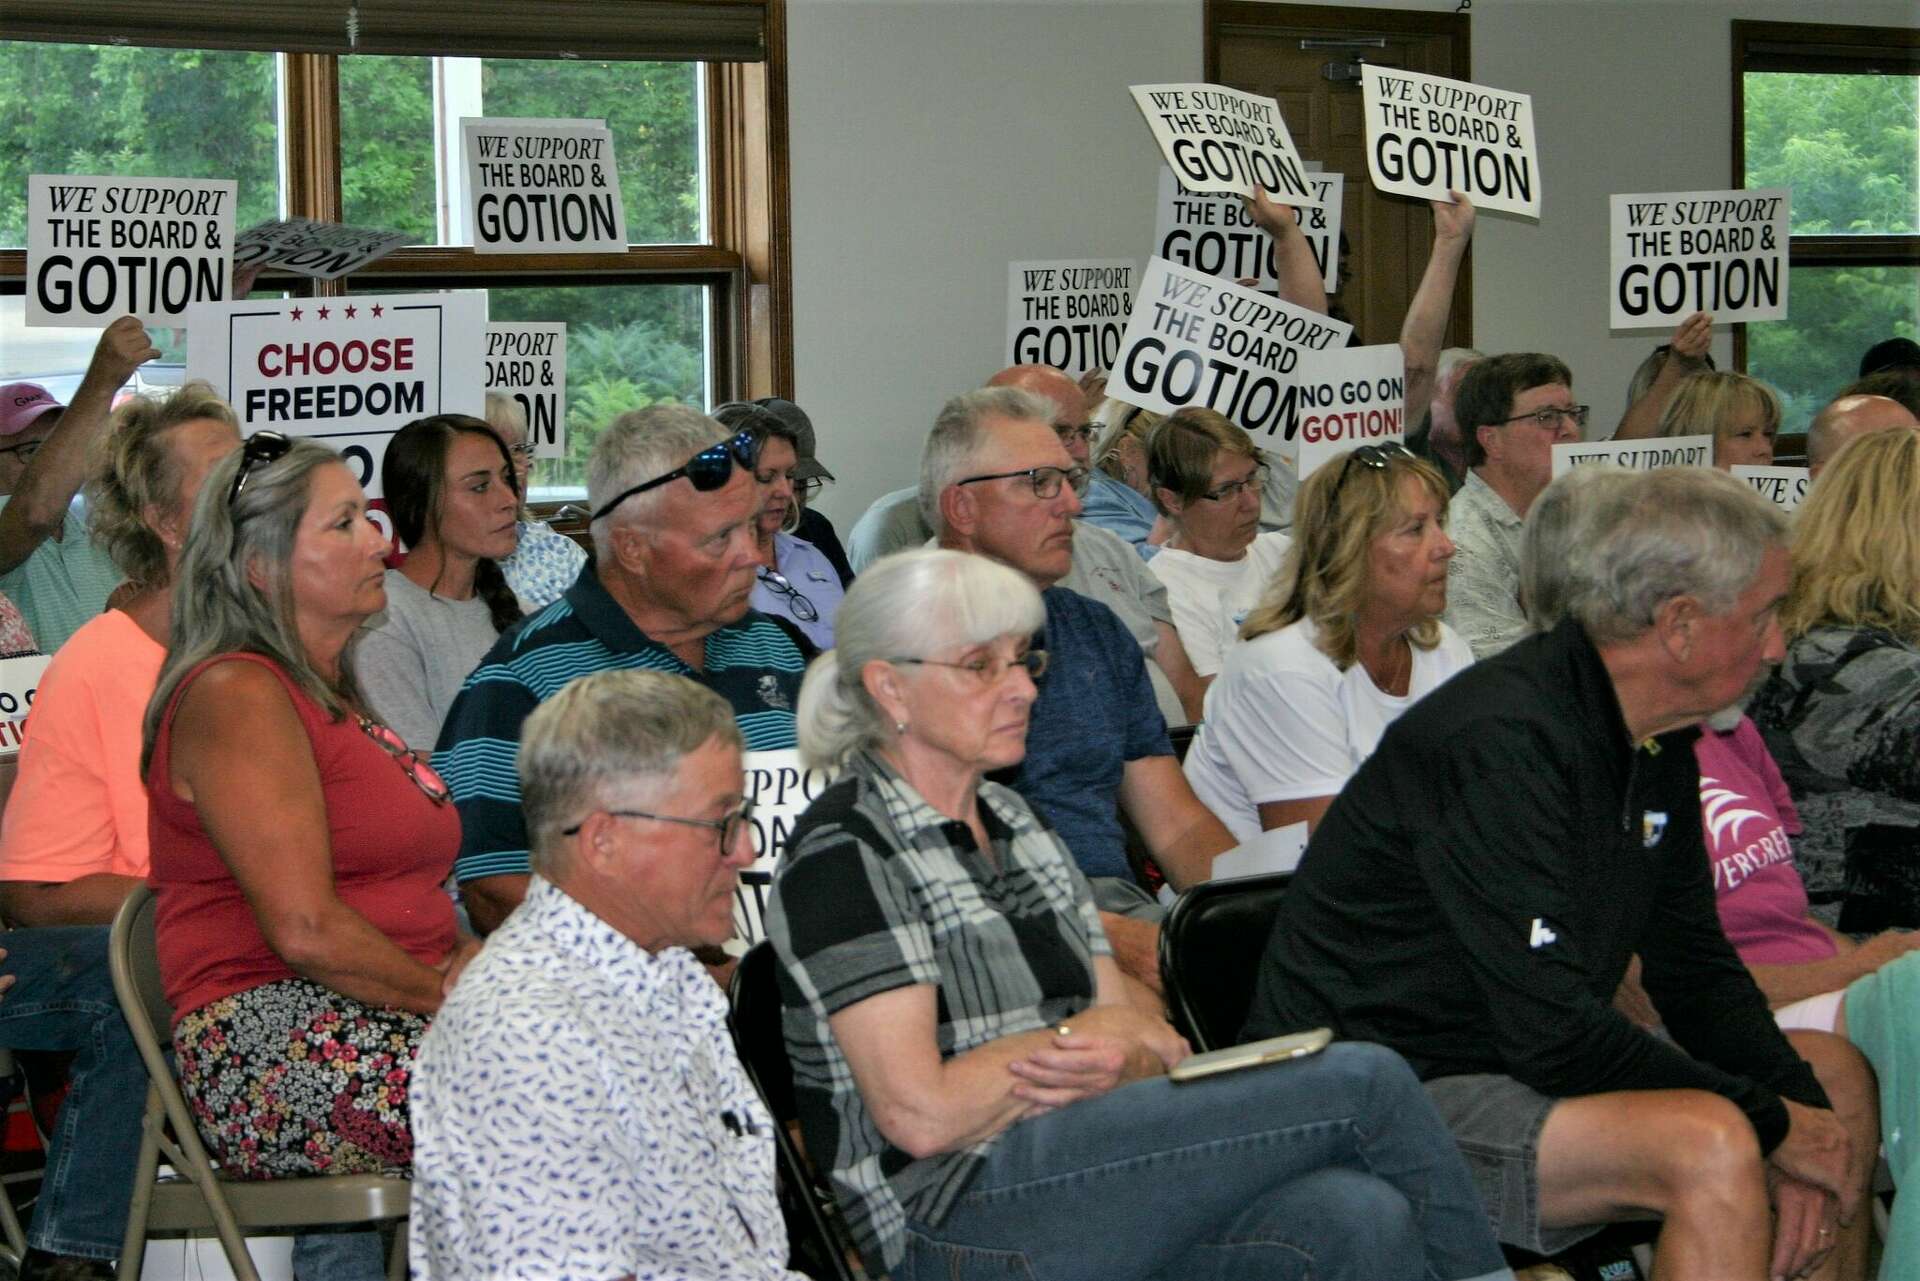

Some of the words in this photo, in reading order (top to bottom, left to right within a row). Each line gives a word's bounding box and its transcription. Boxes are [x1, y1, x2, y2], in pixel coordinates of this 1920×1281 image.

[1149, 91, 1187, 110] WE
[1191, 91, 1272, 125] SUPPORT
[1378, 76, 1414, 101] WE
[1419, 83, 1522, 121] SUPPORT
[1161, 114, 1206, 134] THE
[1209, 115, 1265, 146] BOARD
[1267, 128, 1285, 149] &
[1380, 103, 1421, 131] THE
[1428, 110, 1499, 144] BOARD
[1507, 124, 1522, 149] &
[478, 136, 508, 158] WE
[513, 136, 604, 159] SUPPORT
[479, 163, 515, 187] THE
[520, 163, 585, 187] BOARD
[591, 163, 607, 187] &
[1173, 139, 1309, 197] GOTION
[1376, 133, 1531, 202] GOTION
[48, 186, 96, 214] WE
[102, 187, 227, 216] SUPPORT
[477, 193, 617, 243] GOTION
[1173, 201, 1216, 226] THE
[1224, 203, 1302, 228] BOD
[1310, 208, 1327, 229] &
[1627, 203, 1667, 227] WE
[1672, 198, 1783, 226] SUPPORT
[48, 219, 101, 248] THE
[112, 220, 197, 249] BOARD
[205, 220, 221, 249] &
[1627, 231, 1671, 257] THE
[1680, 227, 1754, 255] BOARD
[1760, 224, 1776, 250] &
[234, 243, 367, 273] OTION
[37, 255, 224, 315] GOTION
[1024, 270, 1056, 292] WE
[1060, 267, 1131, 290] SUPPORT
[1619, 256, 1779, 316] GOTION
[1022, 296, 1060, 320] THE
[1067, 294, 1119, 319] BOARD
[1123, 292, 1132, 316] &
[1162, 272, 1212, 309] WE
[1211, 291, 1340, 350] SUPPORT
[485, 332, 559, 356] PPORT
[1014, 322, 1128, 371] GOTIO
[1153, 302, 1205, 344] THE
[1208, 322, 1297, 374] BOARD
[258, 338, 414, 378] CHOOSE
[485, 361, 535, 387] OARD
[540, 360, 554, 386] &
[245, 381, 425, 422] FREEDOM
[1124, 337, 1299, 441] GOTION
[1300, 383, 1334, 408] NO
[1340, 380, 1371, 404] GO
[1377, 377, 1403, 401] ON
[1302, 408, 1402, 443] GOTION!
